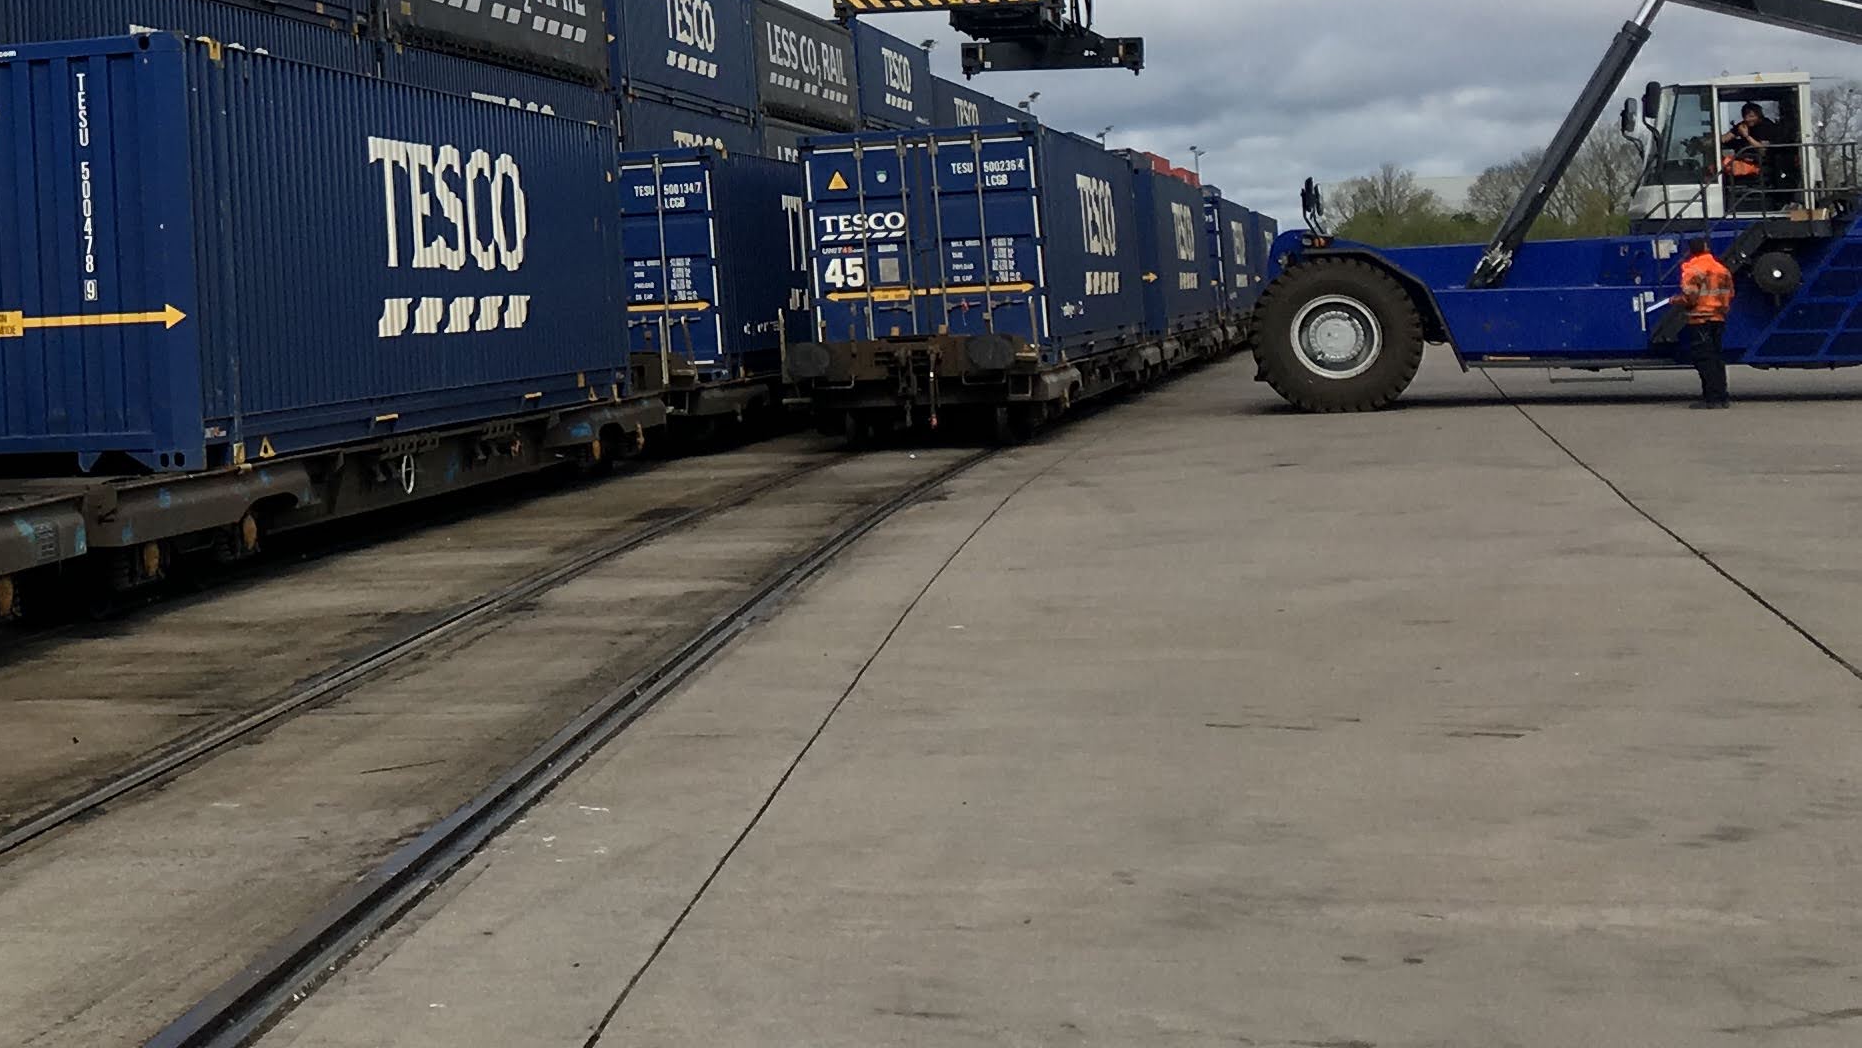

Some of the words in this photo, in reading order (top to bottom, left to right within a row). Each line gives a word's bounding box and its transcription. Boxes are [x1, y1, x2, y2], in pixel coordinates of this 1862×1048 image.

[766, 21, 798, 70] LESS
[821, 42, 847, 86] RAIL
[881, 47, 912, 94] TESCO
[76, 73, 90, 147] TESU
[633, 185, 655, 197] TESU
[951, 162, 974, 174] TESU
[368, 136, 526, 271] TESCO
[819, 212, 906, 233] TESCO
[1076, 173, 1117, 257] TESCO
[824, 257, 865, 288] 45
